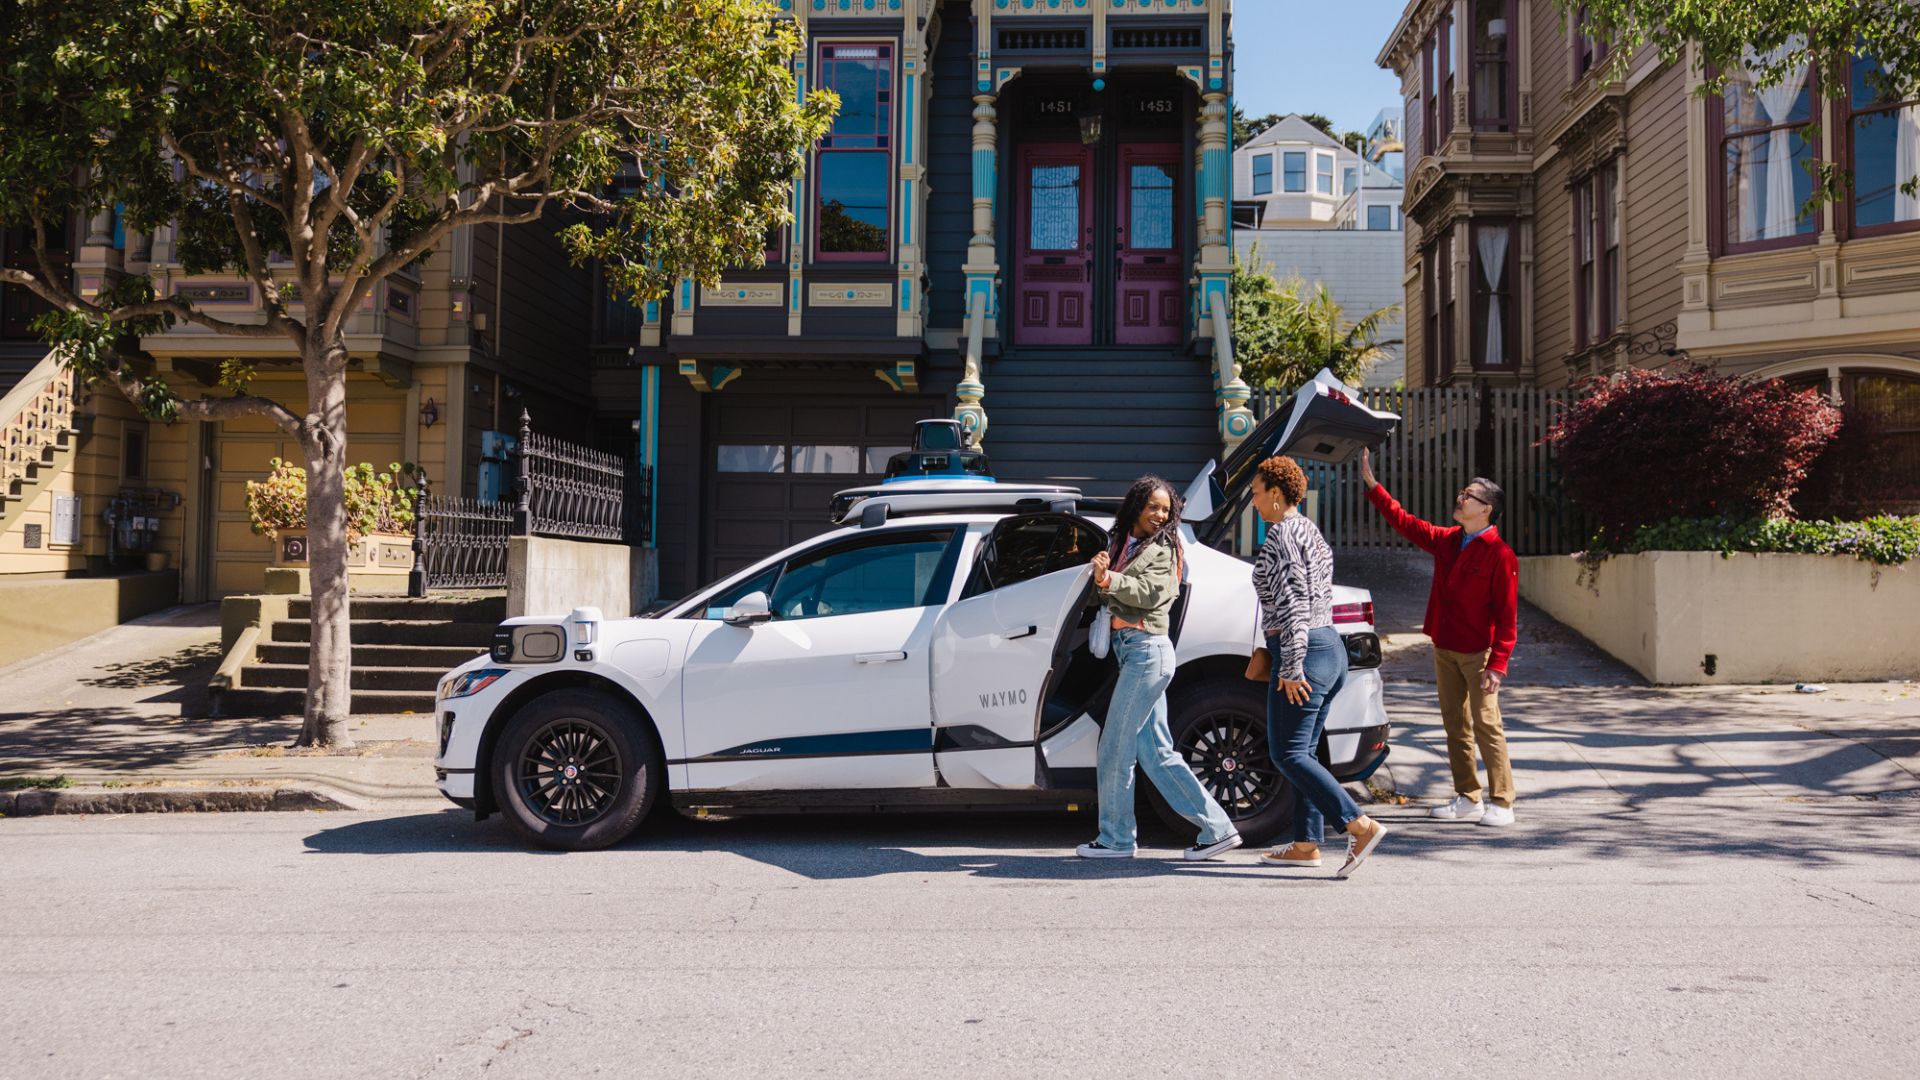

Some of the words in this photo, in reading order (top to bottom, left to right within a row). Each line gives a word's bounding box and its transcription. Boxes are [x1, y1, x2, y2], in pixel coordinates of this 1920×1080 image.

[1040, 100, 1072, 113] 1451
[1140, 100, 1173, 113] 1453
[979, 688, 1027, 709] WAYMO
